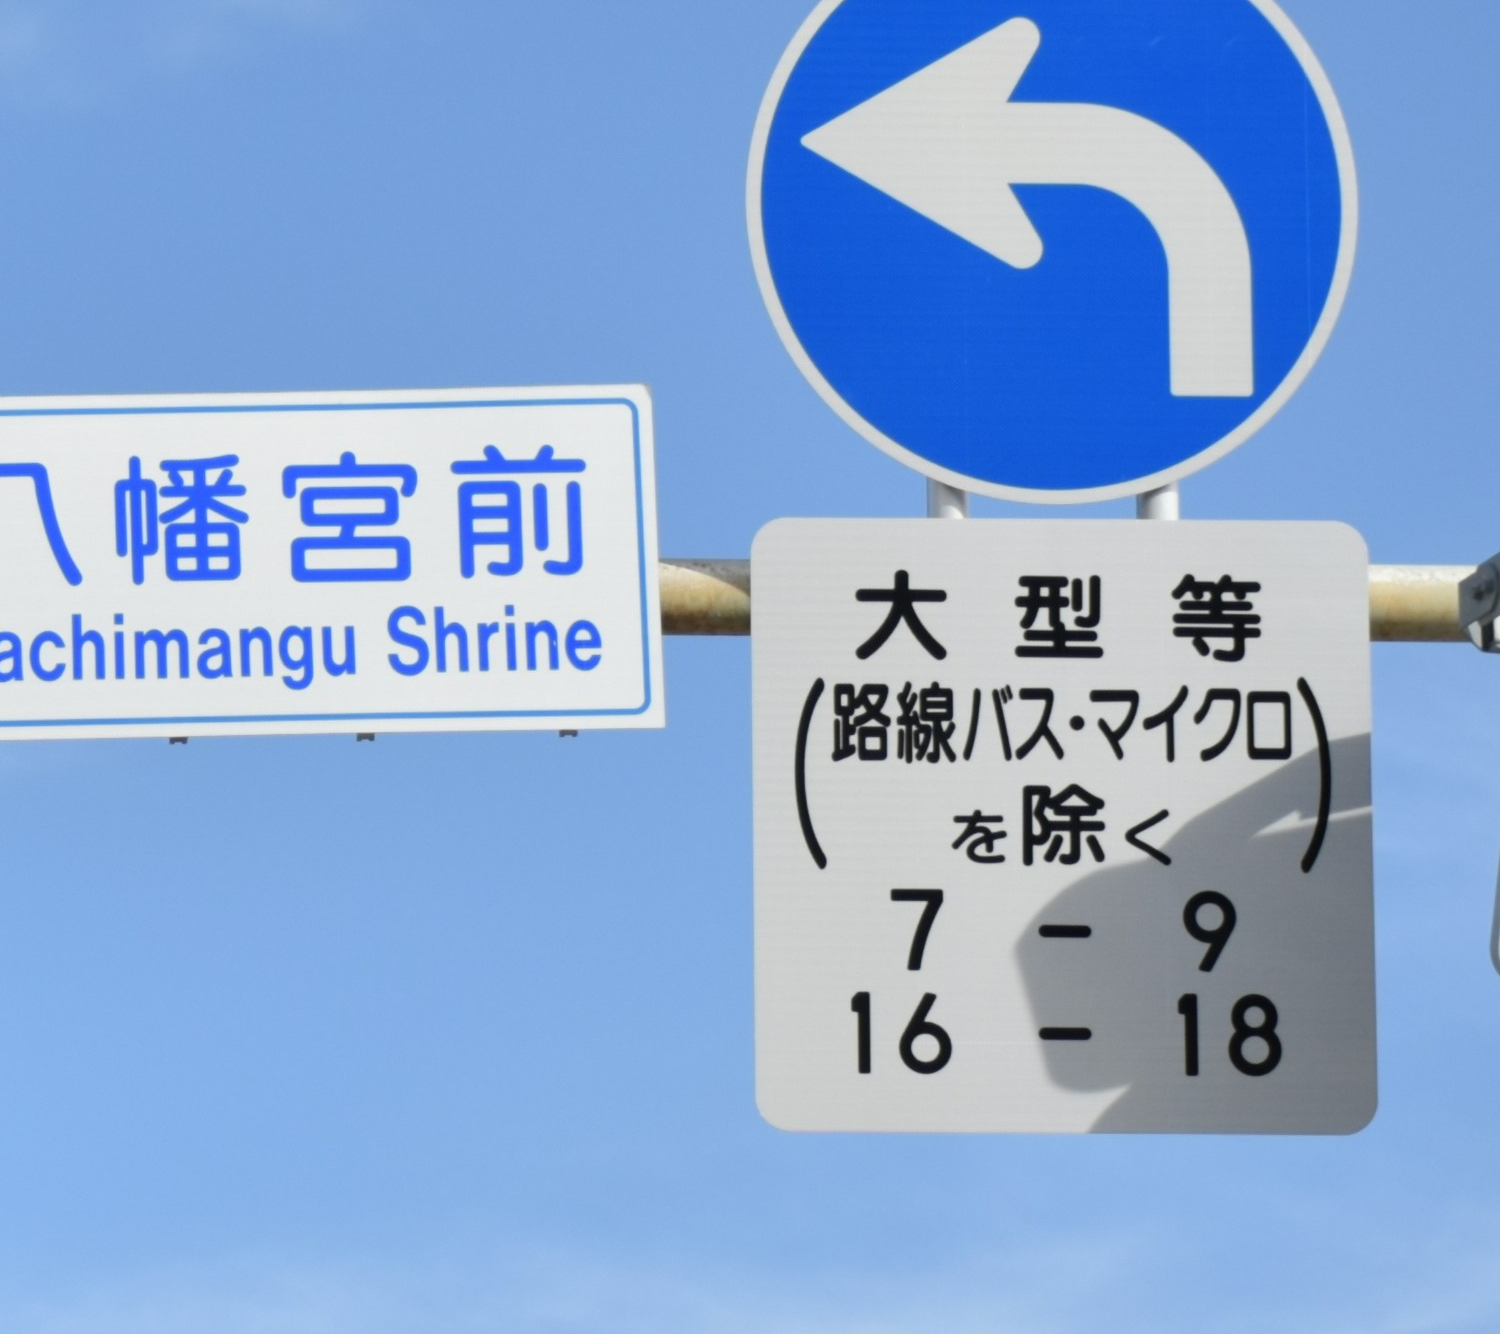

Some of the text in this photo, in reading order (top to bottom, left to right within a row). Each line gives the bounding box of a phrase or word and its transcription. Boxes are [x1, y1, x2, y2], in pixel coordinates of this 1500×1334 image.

[387, 604, 603, 677] Shrine
[856, 570, 1261, 662] 大型等
[890, 889, 944, 971] 7
[1182, 890, 1237, 973] 9
[851, 992, 952, 1074] 16
[1177, 993, 1283, 1077] 18
